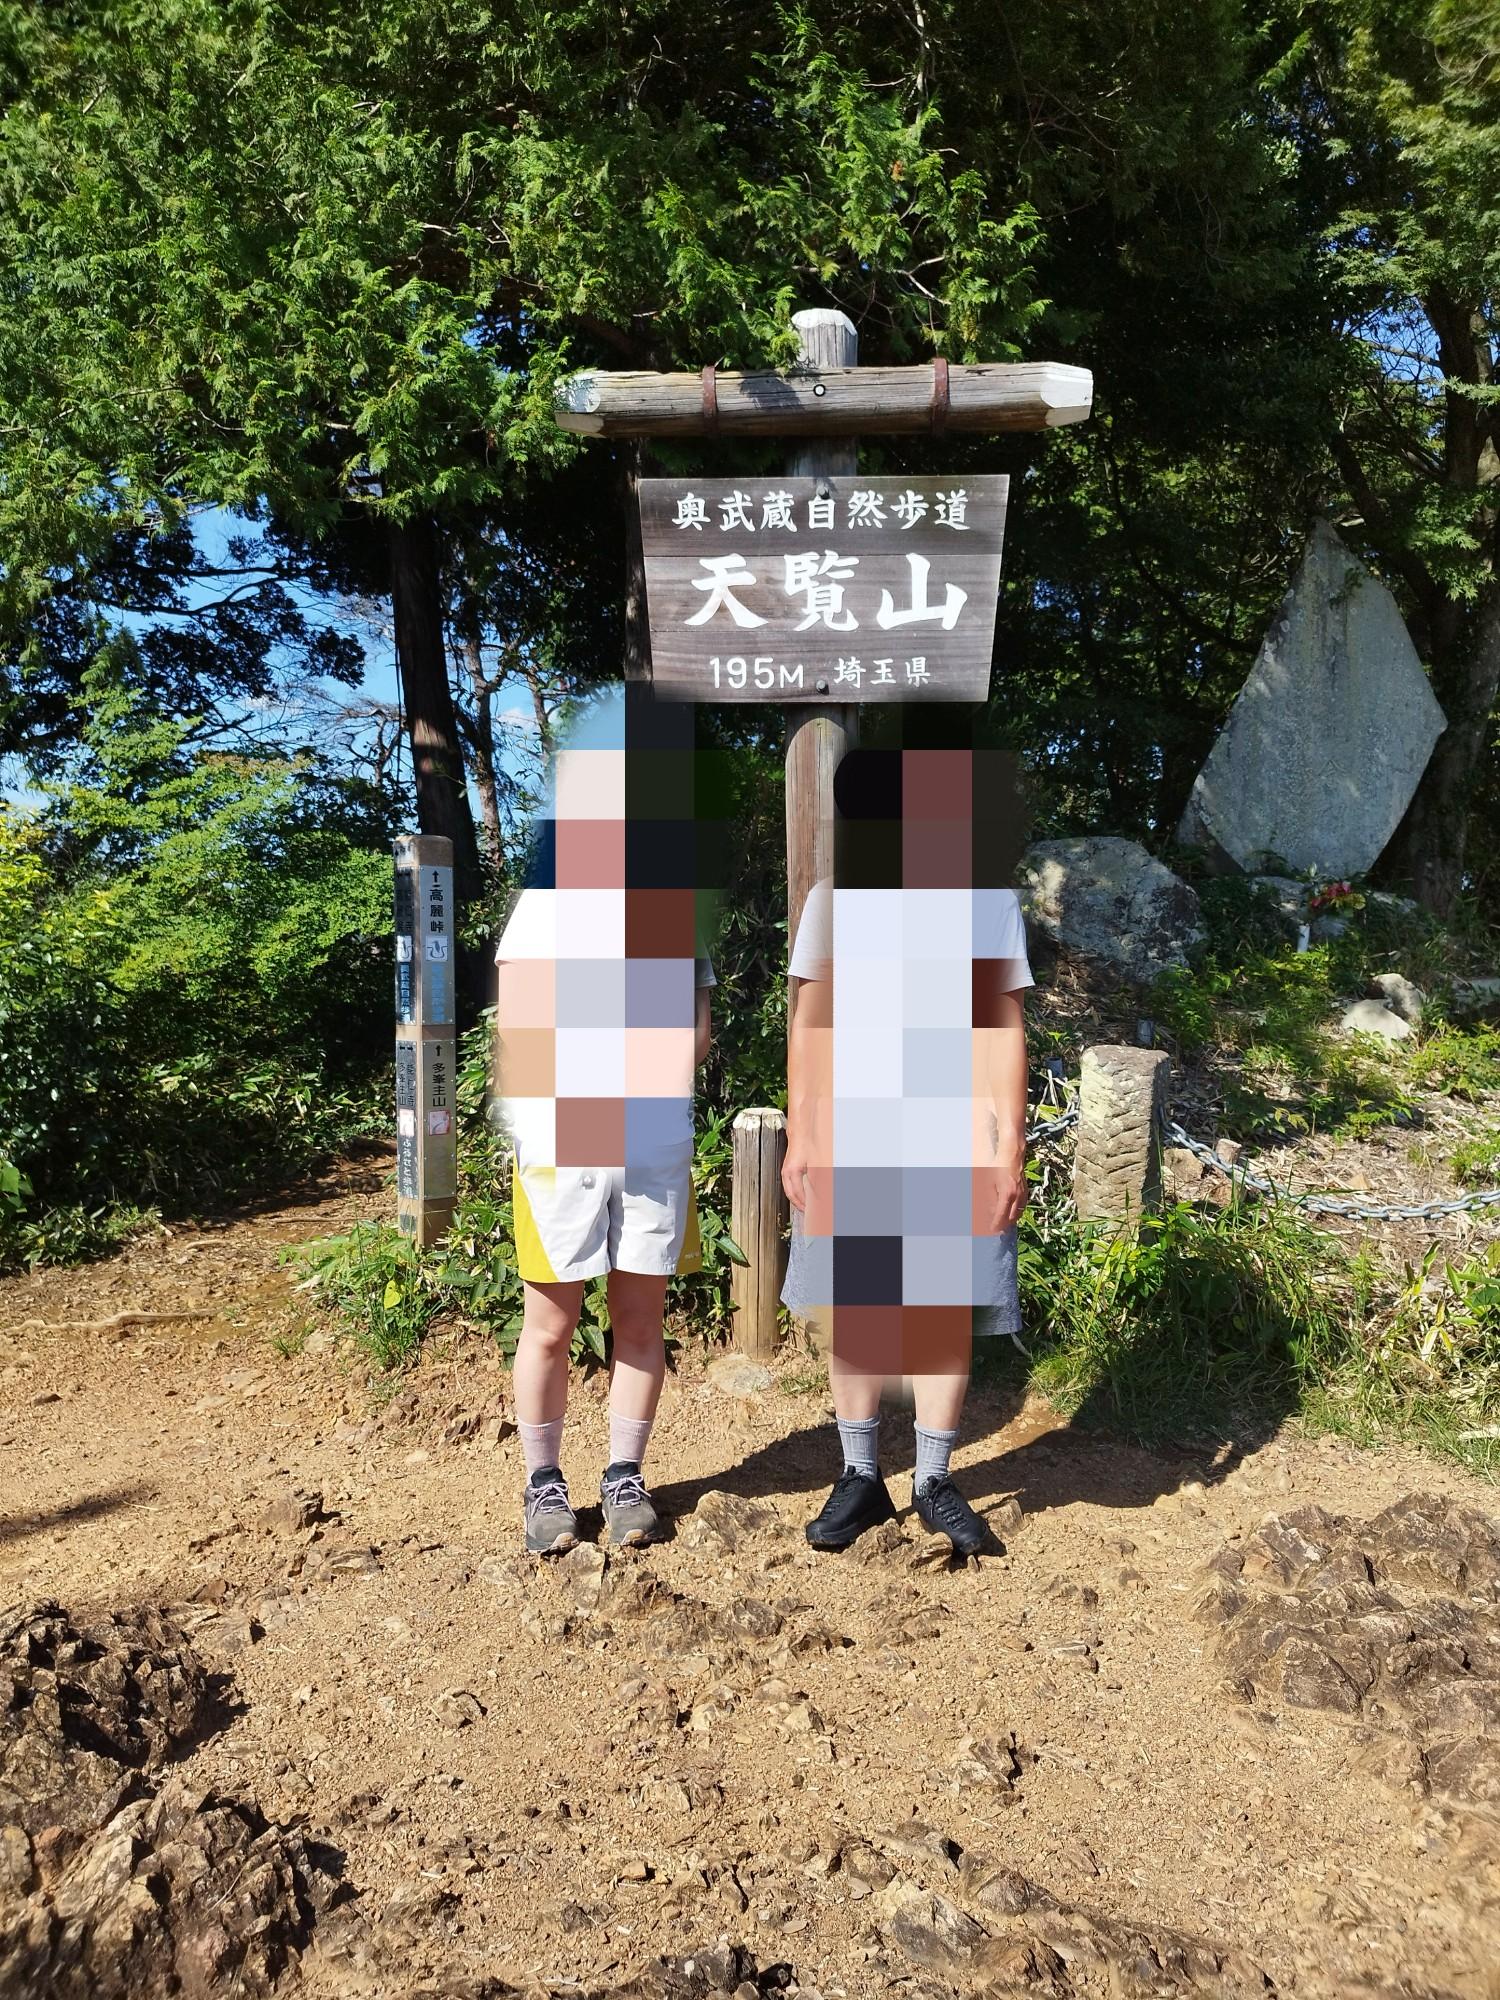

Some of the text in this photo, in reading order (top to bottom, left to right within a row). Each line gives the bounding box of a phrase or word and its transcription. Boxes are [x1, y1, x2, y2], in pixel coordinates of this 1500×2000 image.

[671, 489, 971, 533] 奥武蔵自然歩道
[684, 549, 969, 632] 天覧山
[833, 656, 932, 690] 埼玉県
[429, 885, 444, 934] 高麗峠
[432, 1062, 447, 1107] 多峯主山
